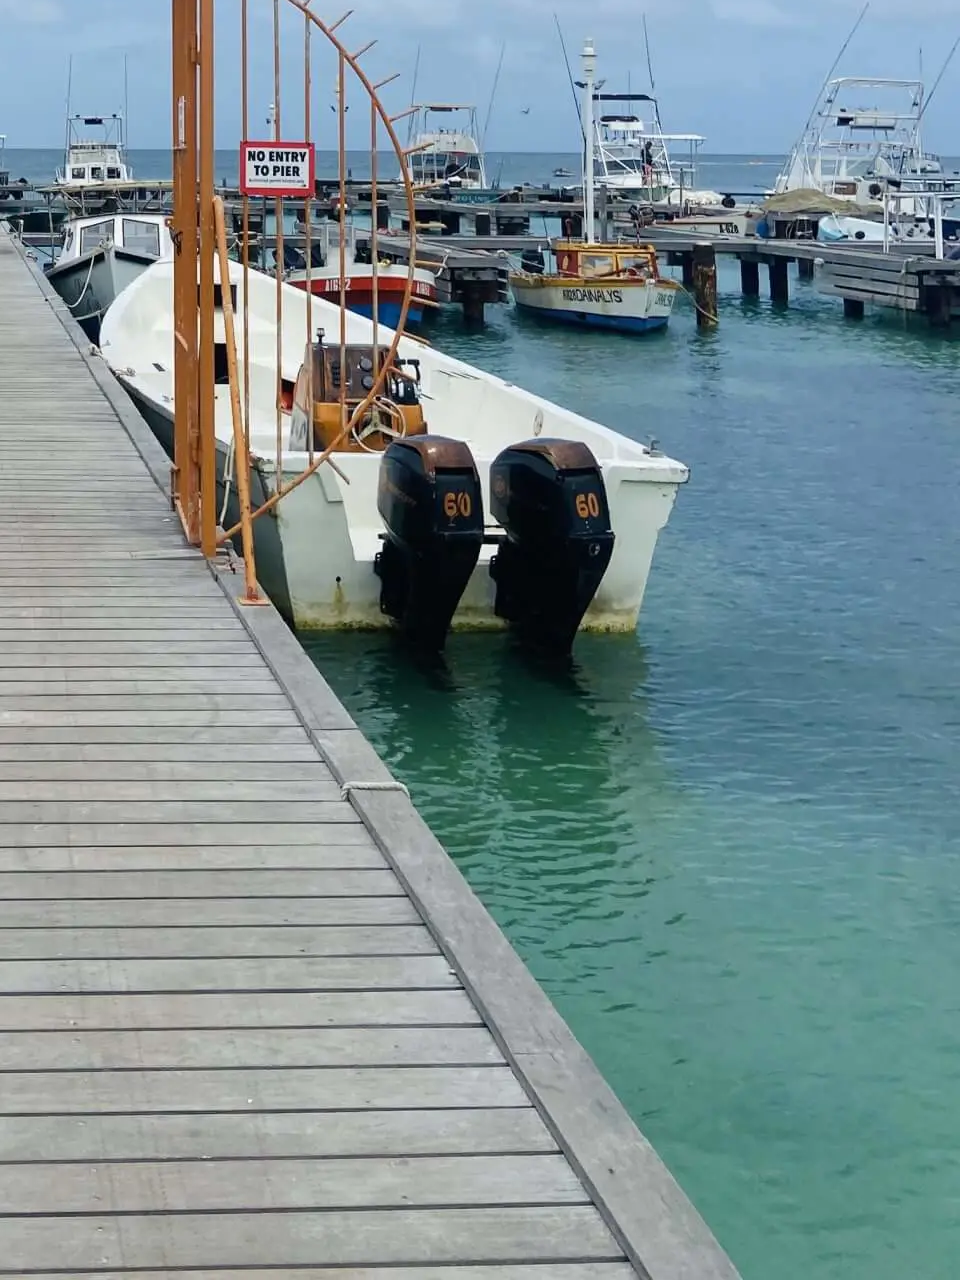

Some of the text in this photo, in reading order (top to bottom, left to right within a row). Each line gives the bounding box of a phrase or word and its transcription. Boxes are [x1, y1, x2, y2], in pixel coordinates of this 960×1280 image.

[247, 150, 307, 163] NO ENTRY
[253, 165, 300, 177] TO PIER
[443, 492, 472, 517] 60
[575, 492, 600, 518] 60
